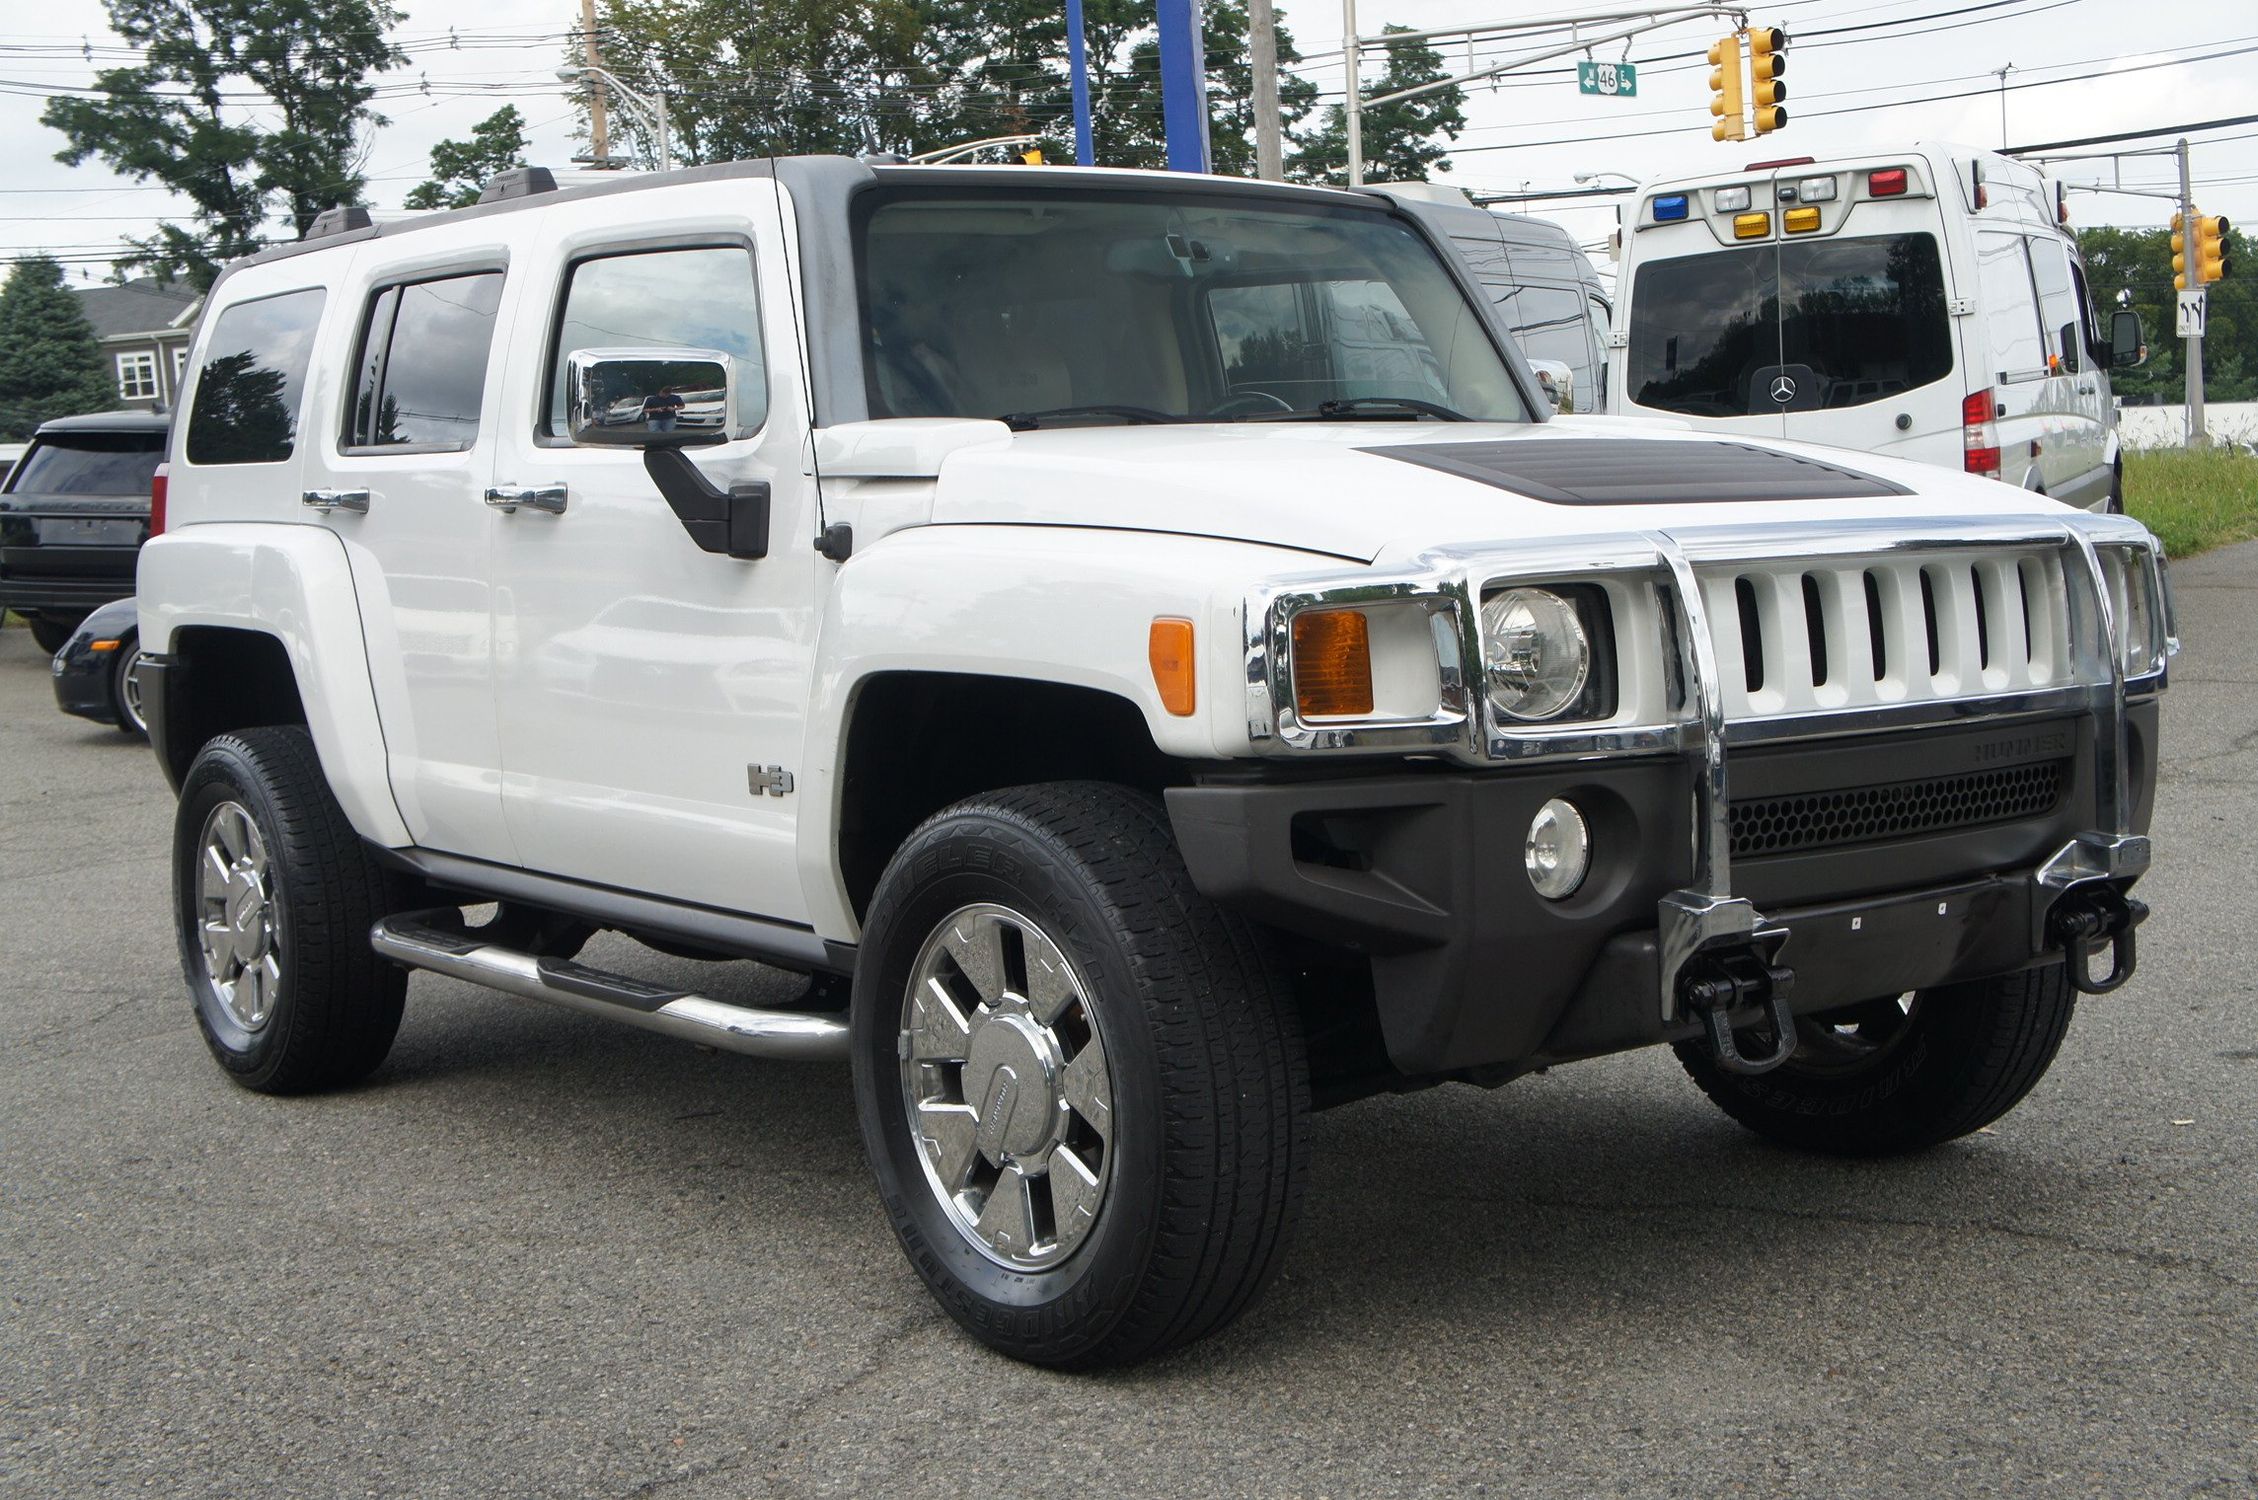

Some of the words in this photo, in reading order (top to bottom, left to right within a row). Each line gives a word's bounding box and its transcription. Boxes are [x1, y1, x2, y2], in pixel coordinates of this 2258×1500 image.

[1600, 70, 1616, 88] 46
[1620, 70, 1625, 81] E
[1975, 733, 2065, 761] HUMMER
[747, 762, 795, 798] H3
